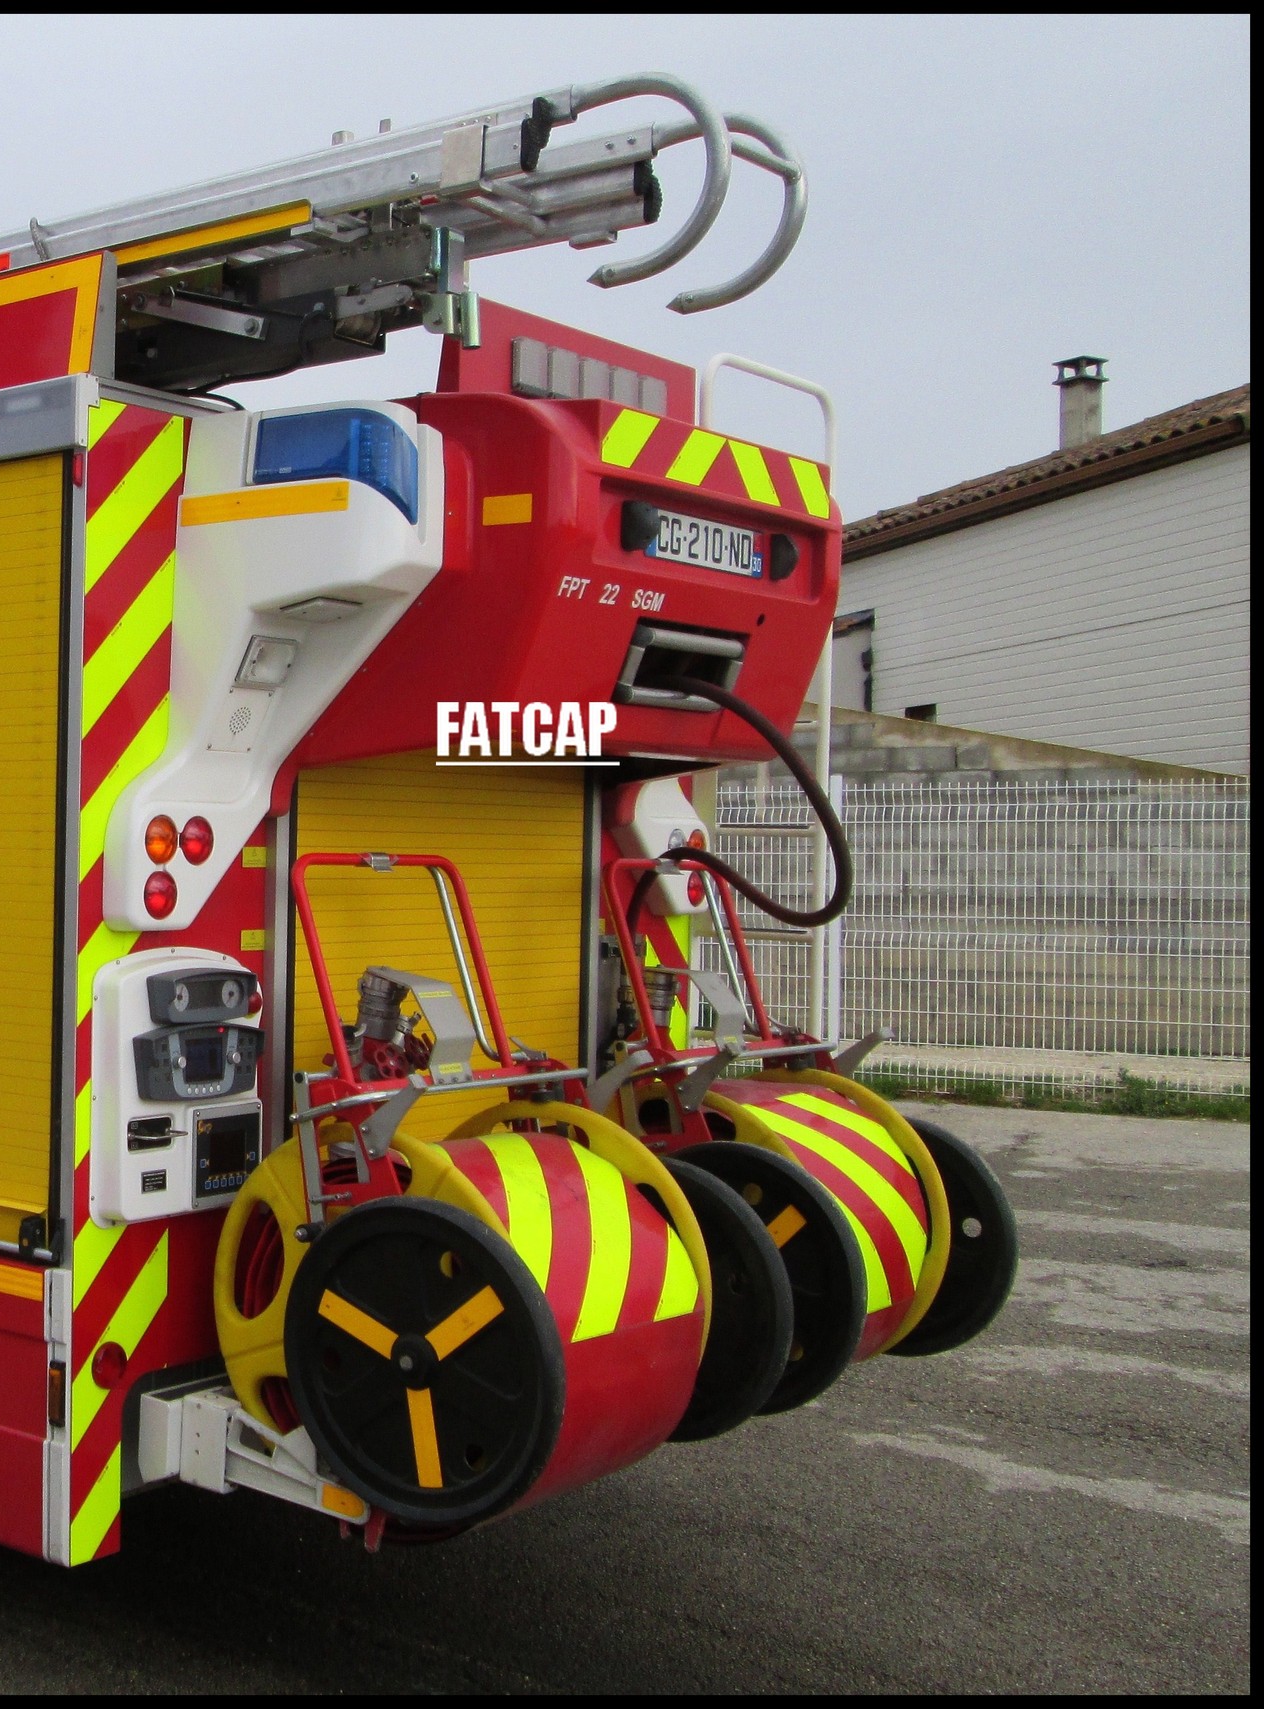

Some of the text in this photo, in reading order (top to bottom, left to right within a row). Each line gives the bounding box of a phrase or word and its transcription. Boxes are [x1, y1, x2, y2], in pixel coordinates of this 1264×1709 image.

[752, 556, 762, 573] 30
[557, 575, 666, 612] FPT 22 SGM
